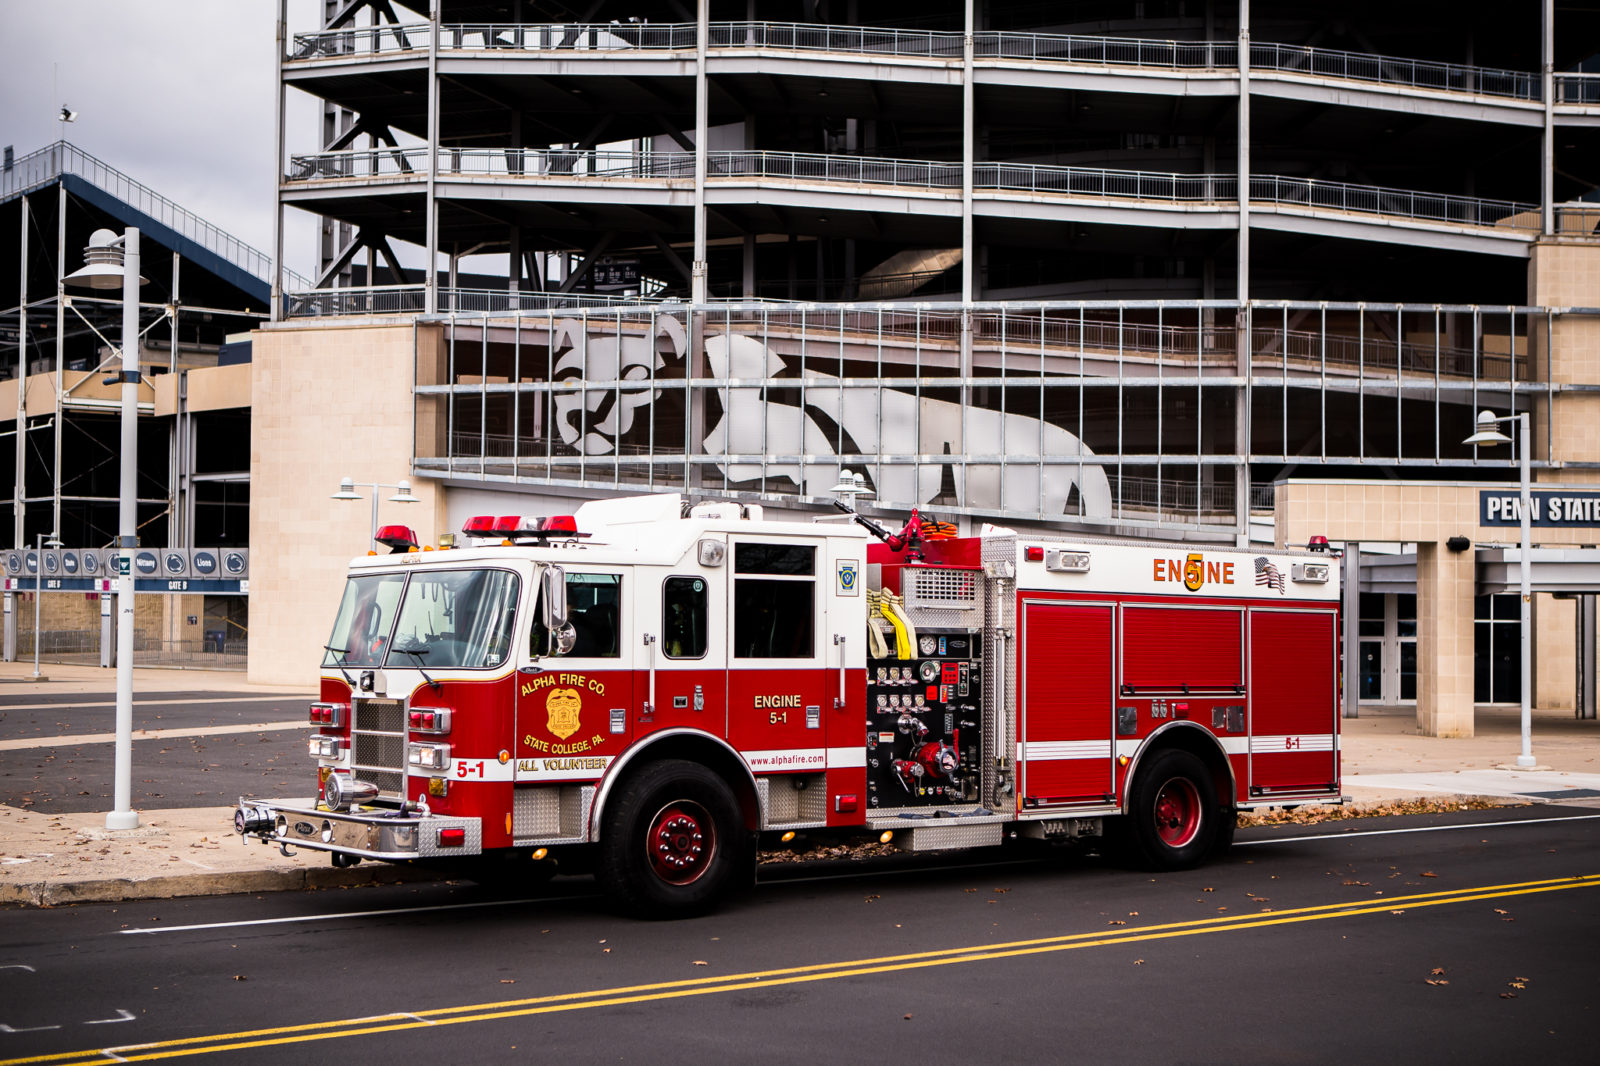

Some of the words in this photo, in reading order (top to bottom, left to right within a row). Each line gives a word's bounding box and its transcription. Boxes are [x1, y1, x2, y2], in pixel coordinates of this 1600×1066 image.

[1548, 497, 1600, 521] STATE
[197, 558, 212, 567] Lions
[1153, 558, 1235, 584] ENGINE
[168, 581, 182, 590] GATE
[182, 581, 188, 590] B
[521, 674, 556, 697] ALPHA
[559, 673, 586, 687] FIRE
[588, 679, 605, 697] CO.
[754, 695, 802, 708] ENGINE
[769, 712, 787, 724] 5-1
[523, 734, 549, 752] STATE
[551, 740, 592, 754] COLLEGE,
[592, 734, 605, 746] PA.
[1285, 737, 1301, 750] 5-1
[518, 759, 538, 772] ALL
[543, 758, 607, 771] VOLUNTEER
[750, 755, 824, 766] www.alphafire.com
[456, 761, 484, 778] 5-1
